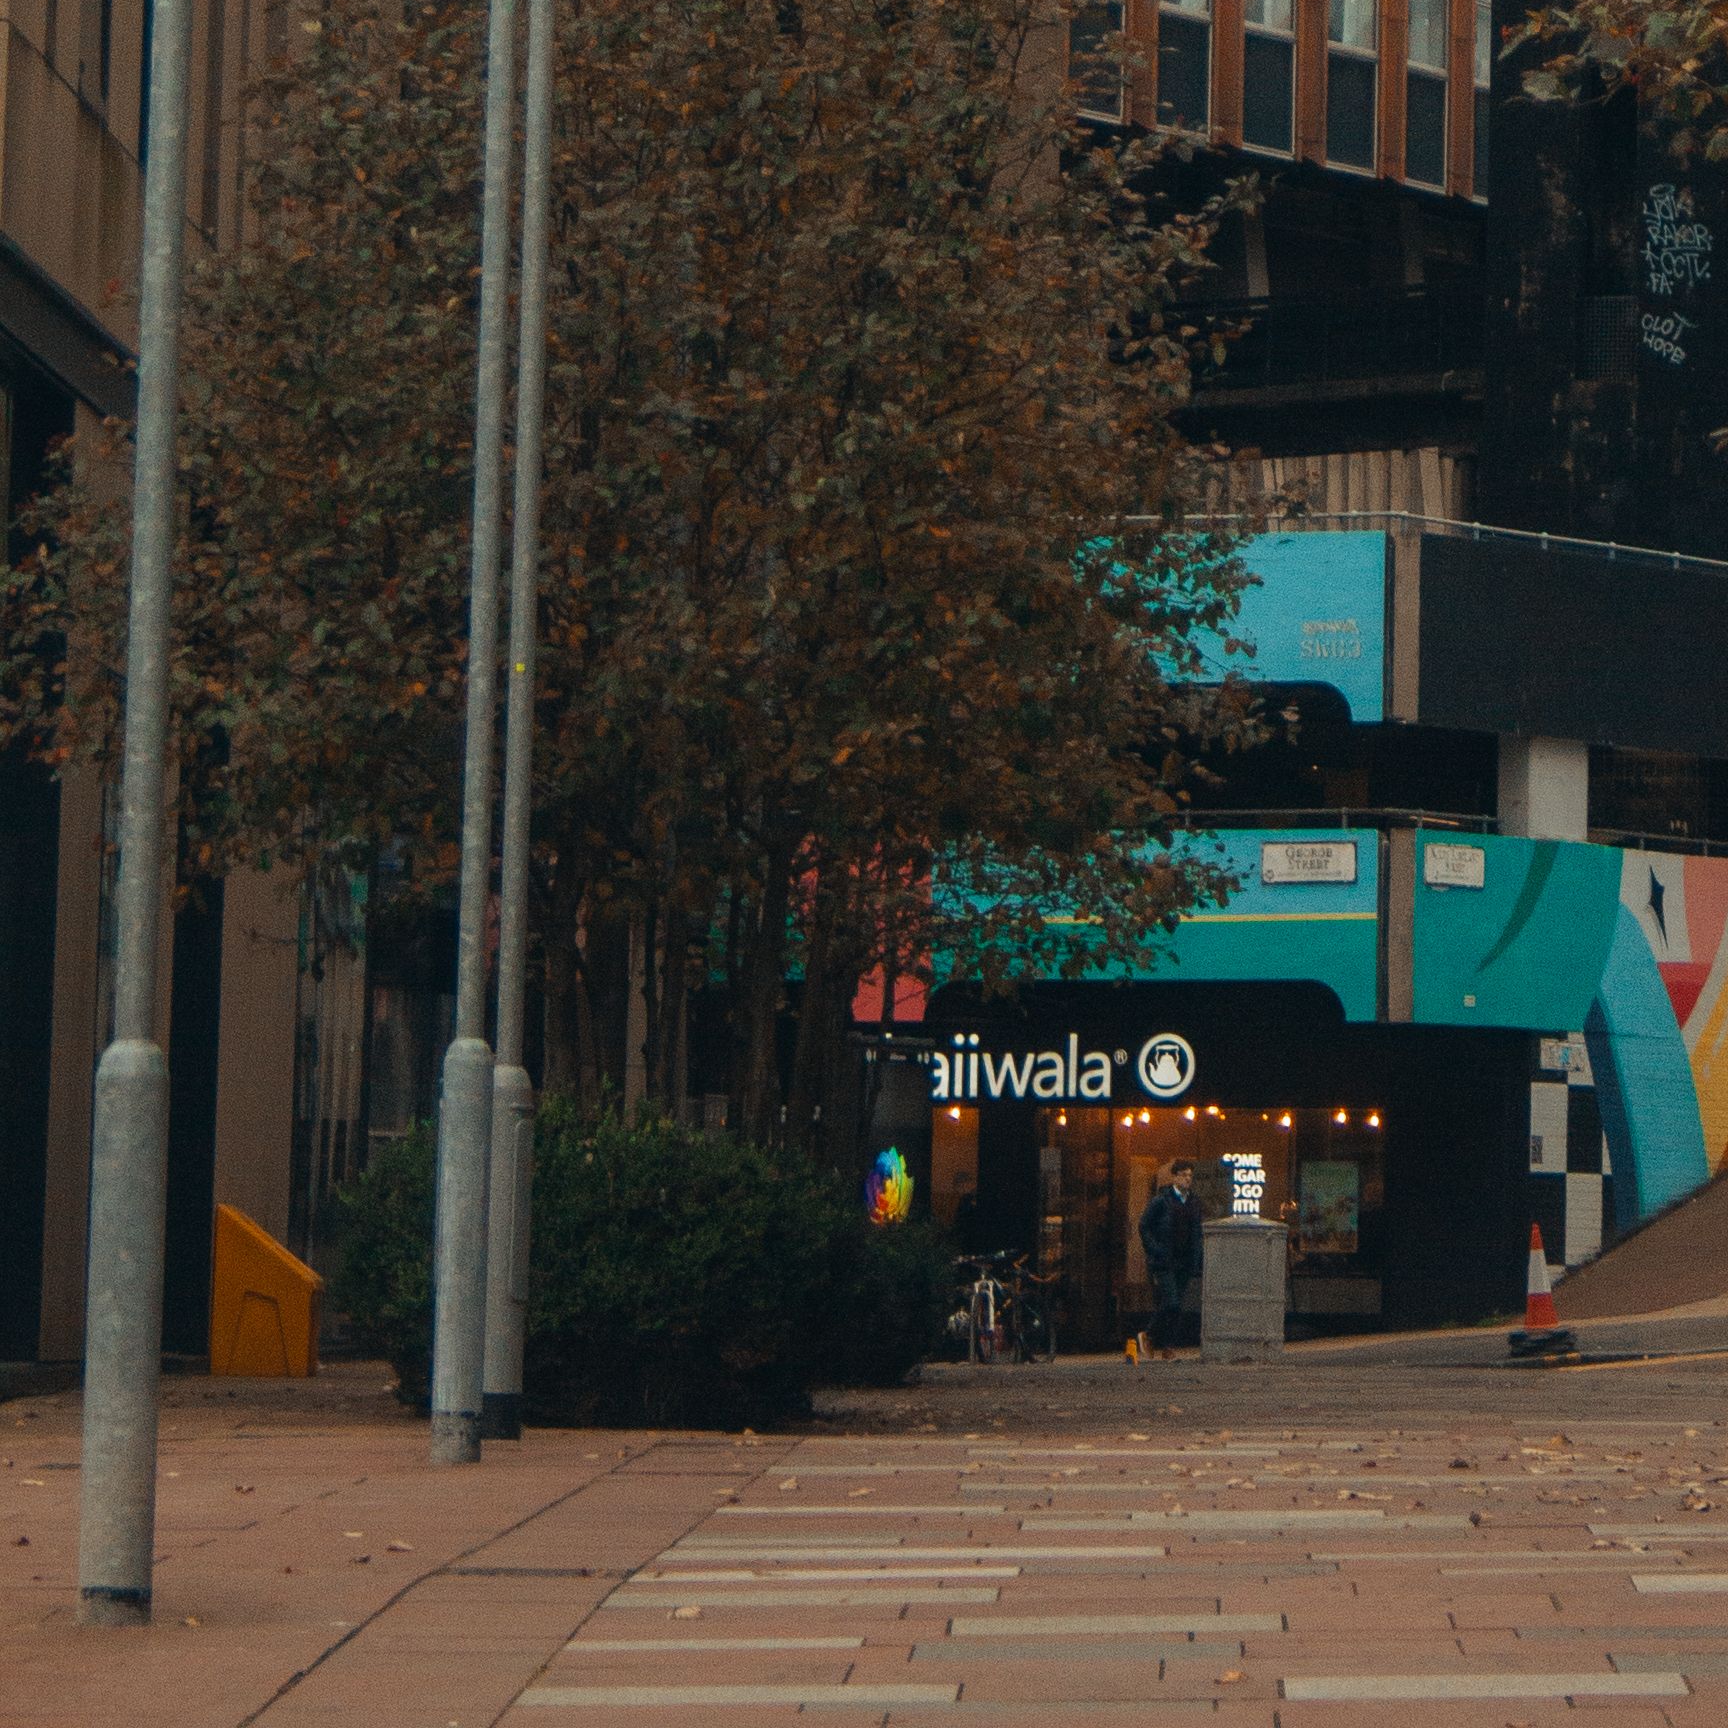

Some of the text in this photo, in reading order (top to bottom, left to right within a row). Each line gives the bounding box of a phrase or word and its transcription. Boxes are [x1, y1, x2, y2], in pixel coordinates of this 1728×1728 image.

[932, 1033, 1112, 1098] aiiwala
[1233, 1169, 1266, 1183] GAR
[1242, 1184, 1263, 1198] GO
[1233, 1199, 1260, 1213] ITH
